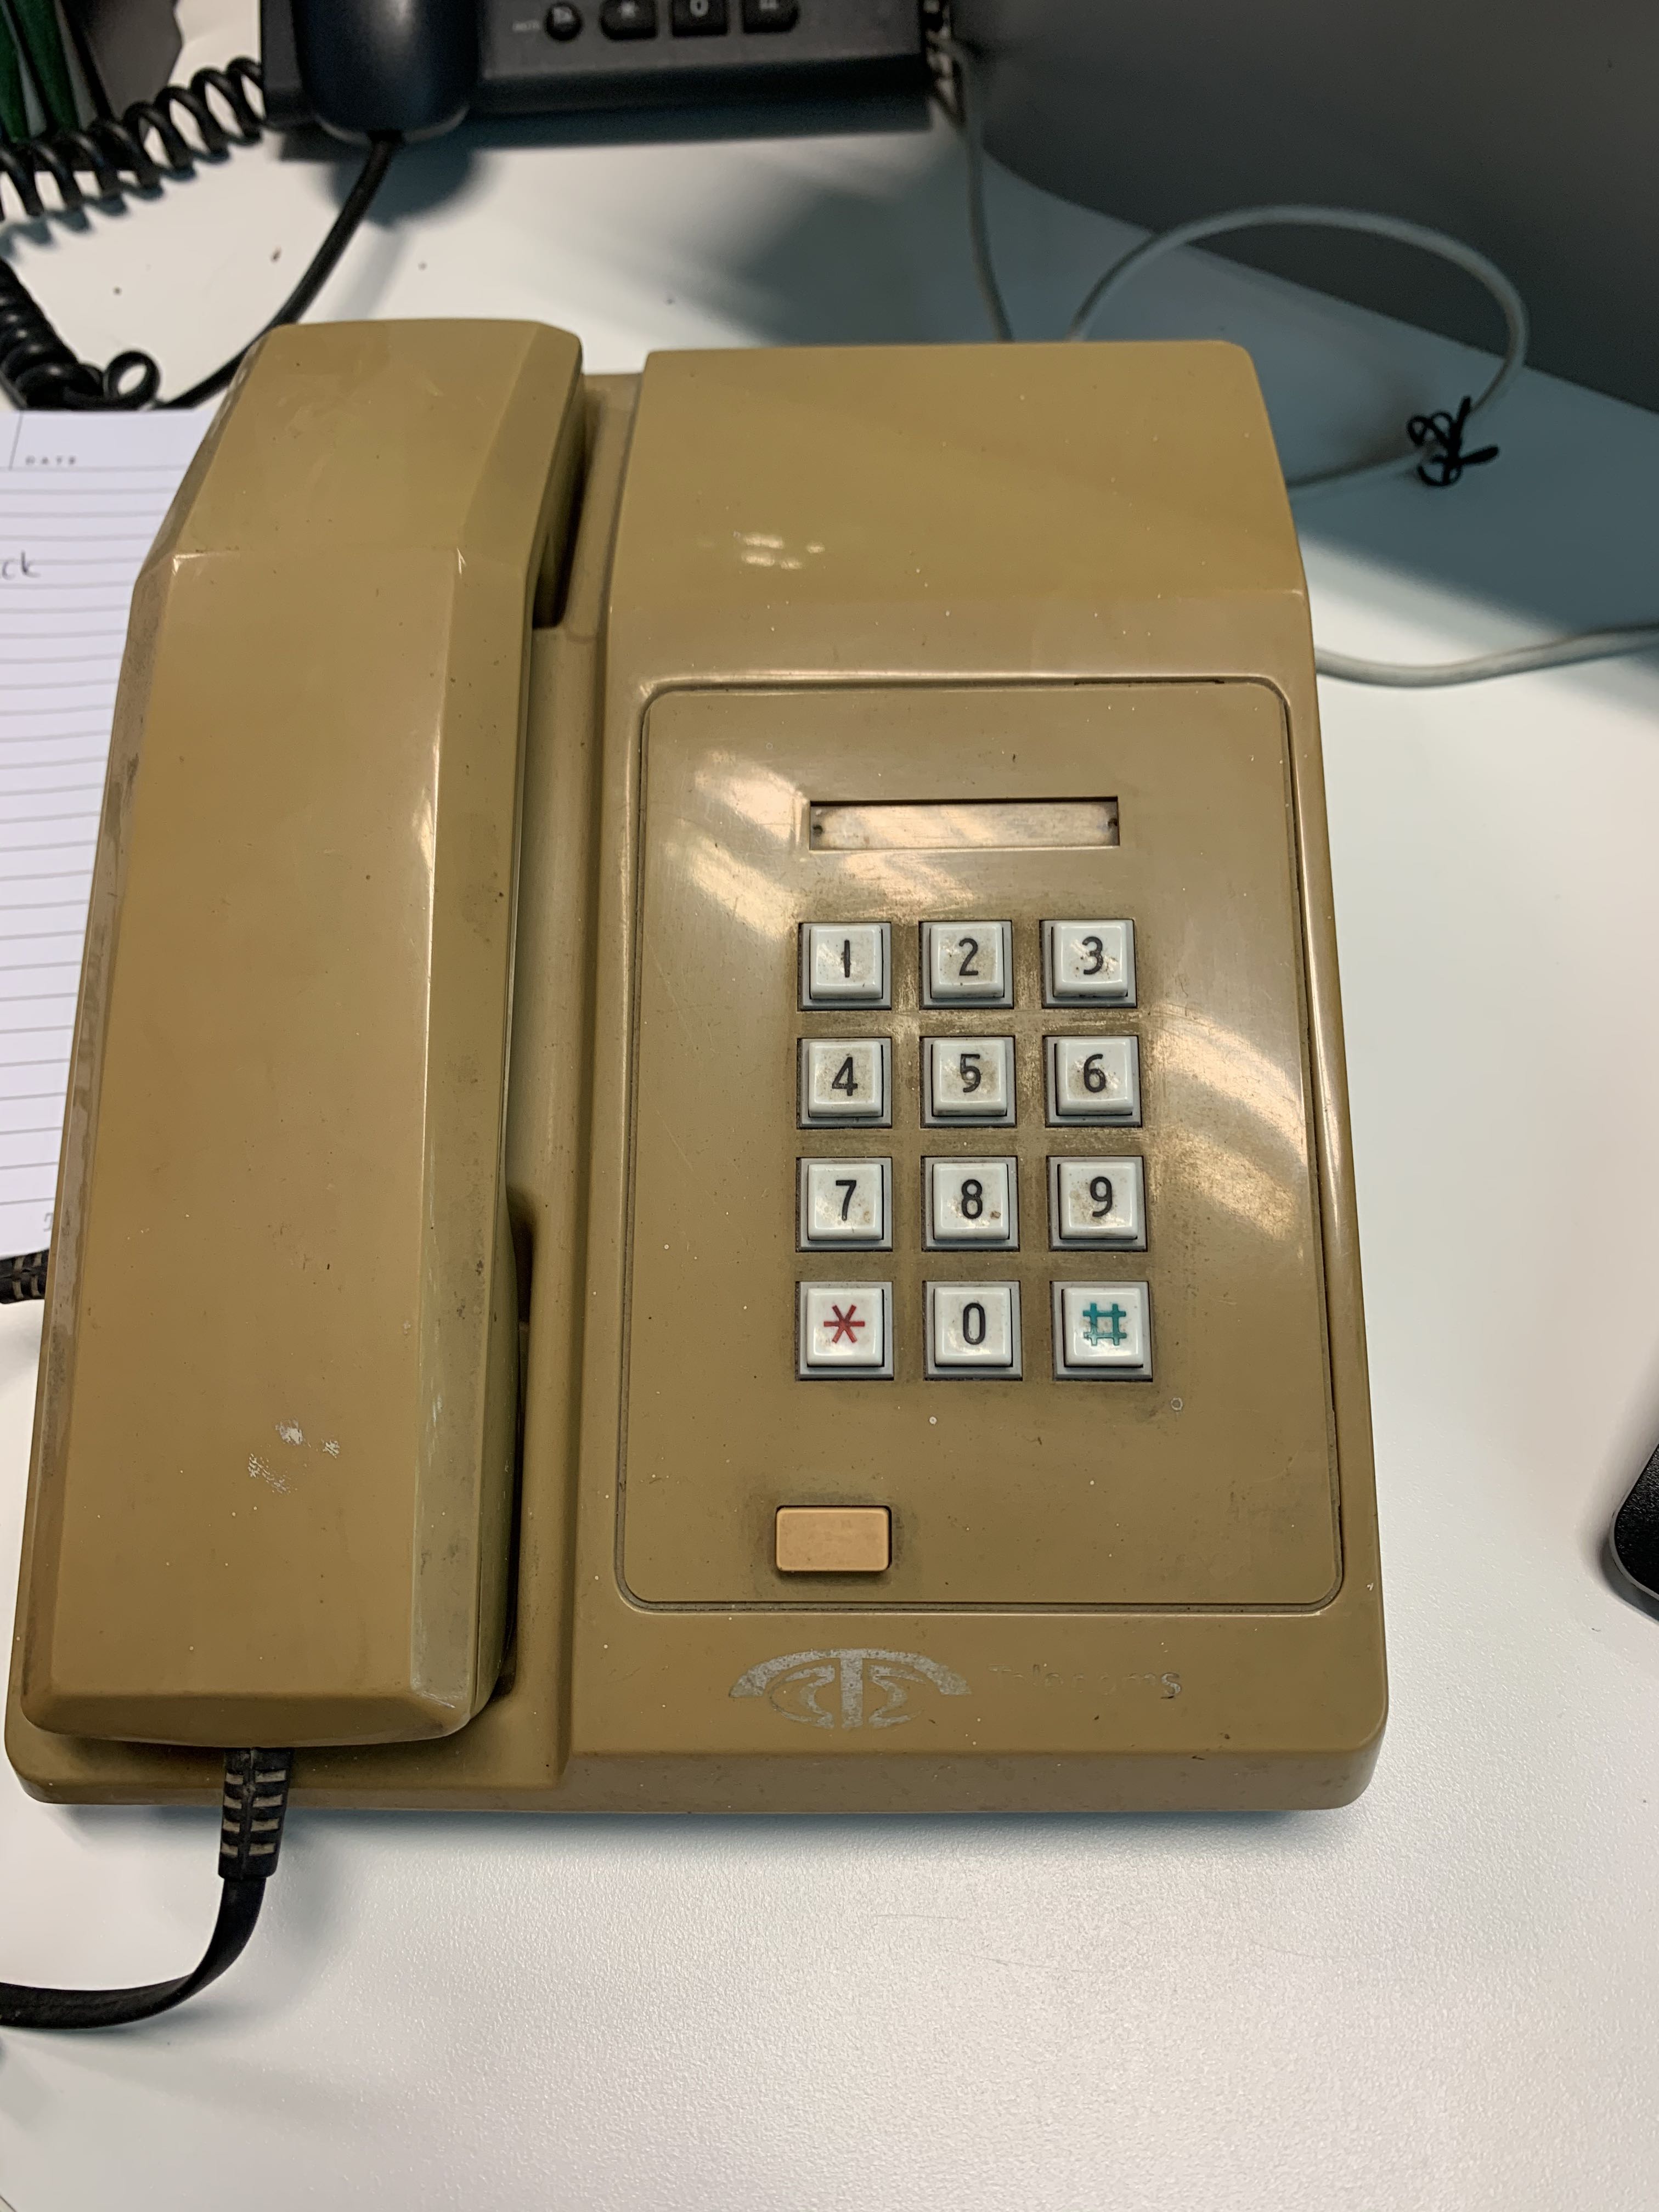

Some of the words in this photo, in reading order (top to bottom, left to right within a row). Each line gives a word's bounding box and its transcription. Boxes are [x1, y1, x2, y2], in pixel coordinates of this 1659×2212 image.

[841, 939, 851, 978] 1
[958, 938, 979, 977] 2
[1082, 936, 1104, 975] 3
[831, 1056, 859, 1097] 4
[960, 1053, 984, 1093] 5
[1082, 1053, 1107, 1094] 6
[835, 1179, 857, 1221] 7
[961, 1178, 983, 1220] 8
[1089, 1176, 1113, 1218] 9
[962, 1302, 986, 1345] 0
